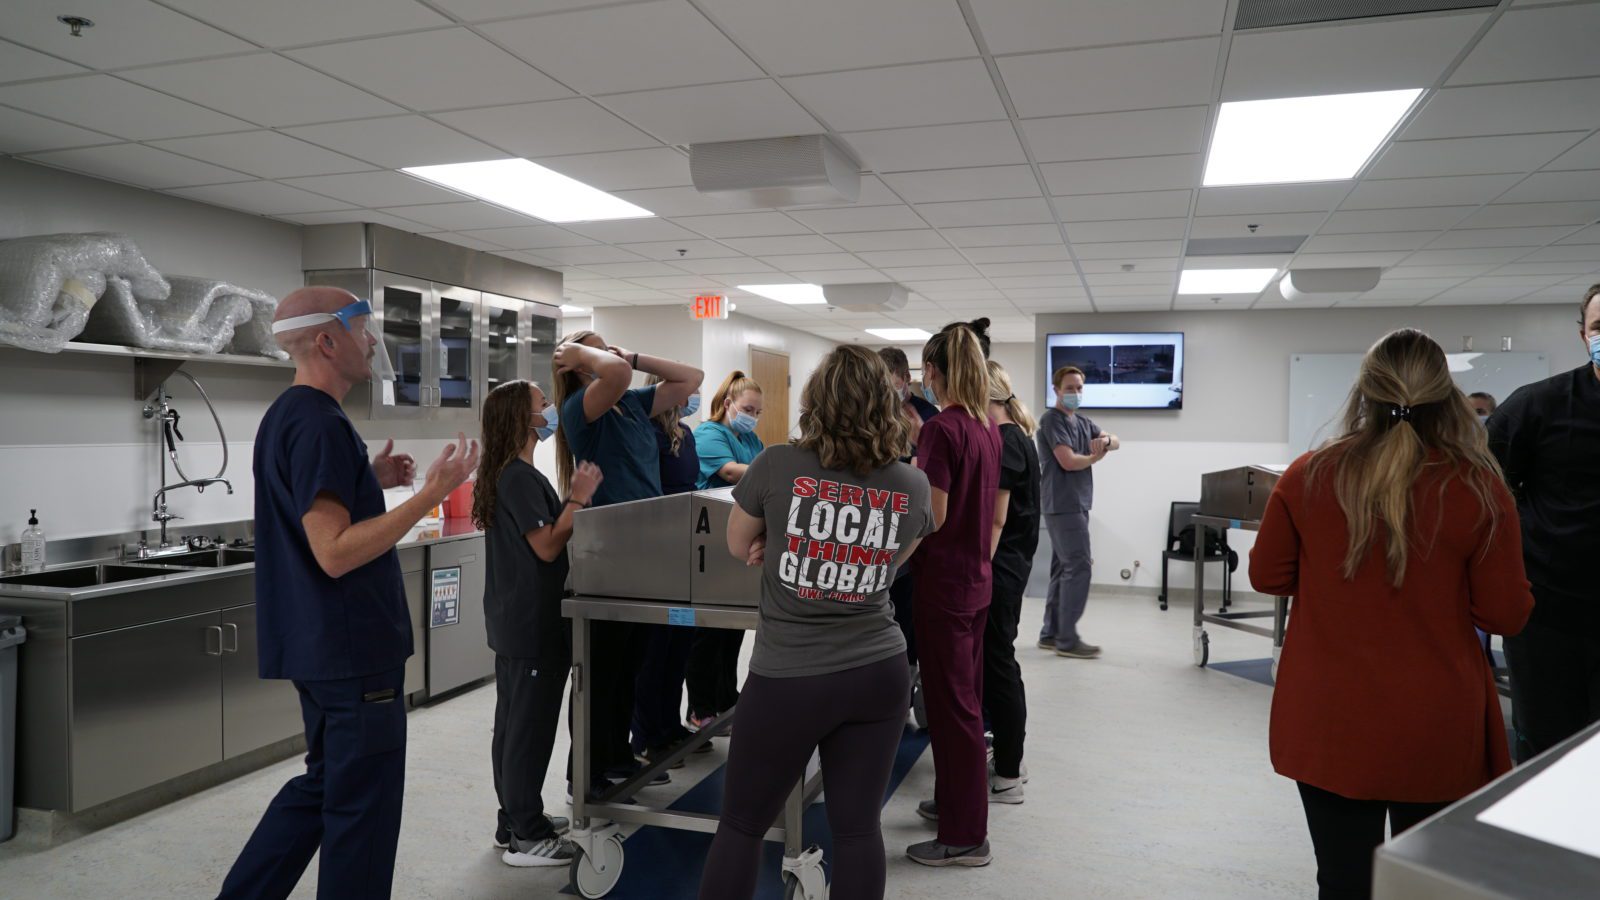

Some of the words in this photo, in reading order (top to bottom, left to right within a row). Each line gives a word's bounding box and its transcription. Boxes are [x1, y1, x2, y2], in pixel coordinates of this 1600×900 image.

[695, 295, 721, 319] EXIT
[1247, 471, 1255, 486] C
[792, 476, 909, 514] SERVE
[695, 506, 711, 534] A
[786, 495, 901, 550] LOCAL
[698, 544, 705, 573] 1
[785, 533, 899, 566] THINK
[778, 551, 888, 594] GLOBAL
